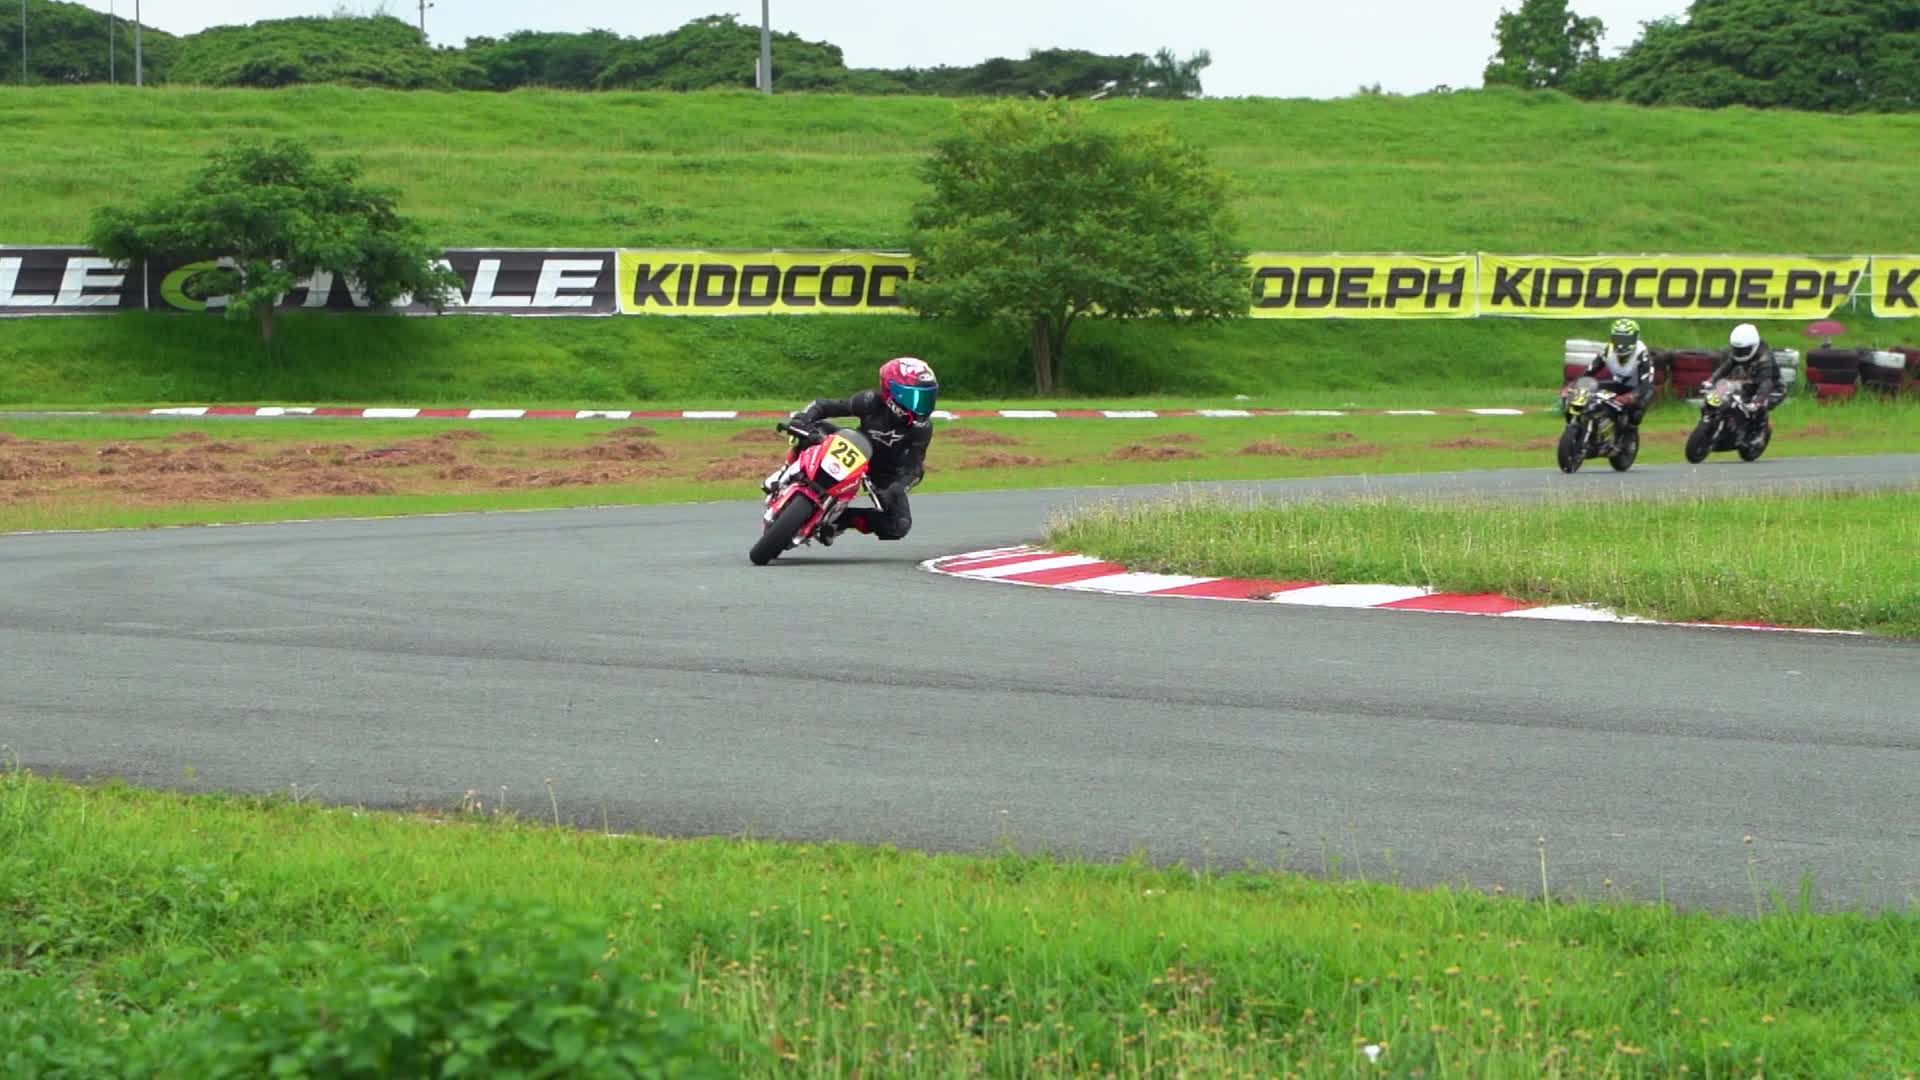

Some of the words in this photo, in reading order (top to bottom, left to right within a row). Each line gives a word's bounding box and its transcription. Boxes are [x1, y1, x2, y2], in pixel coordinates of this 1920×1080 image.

[634, 263, 926, 306] KIDDCOD
[1490, 267, 1860, 309] KIDDCODE.PH
[830, 441, 859, 468] 25
